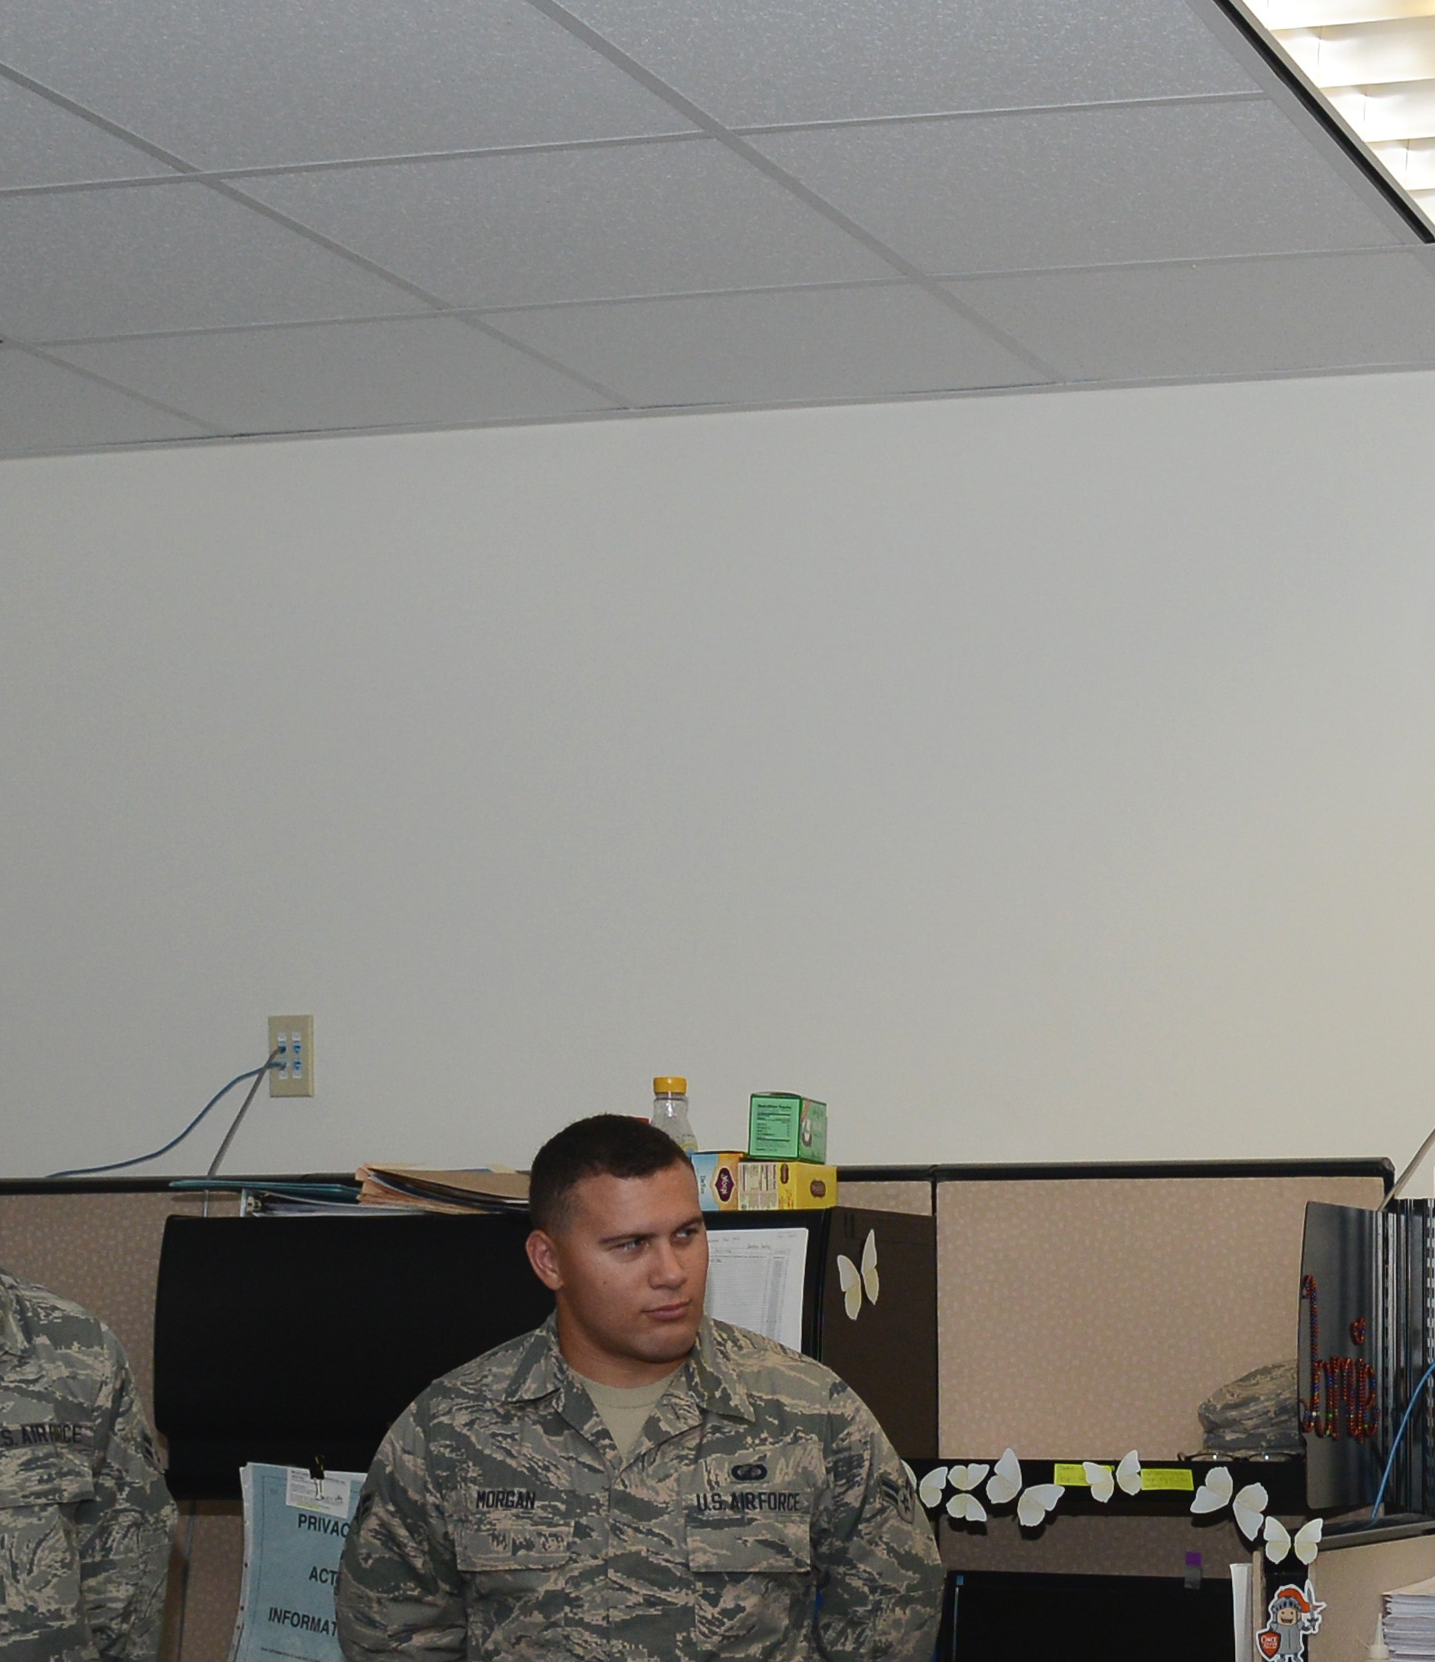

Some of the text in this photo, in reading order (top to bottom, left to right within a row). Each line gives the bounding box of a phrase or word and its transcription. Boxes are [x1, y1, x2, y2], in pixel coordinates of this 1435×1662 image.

[22, 1424, 49, 1445] AIR
[49, 1423, 82, 1444] FCE
[476, 1490, 535, 1510] MORGAN
[696, 1492, 801, 1511] U.S. AIR FORCE
[298, 1513, 350, 1538] PRIVAC
[309, 1566, 337, 1586] ACT
[268, 1606, 337, 1637] INFORMAT
